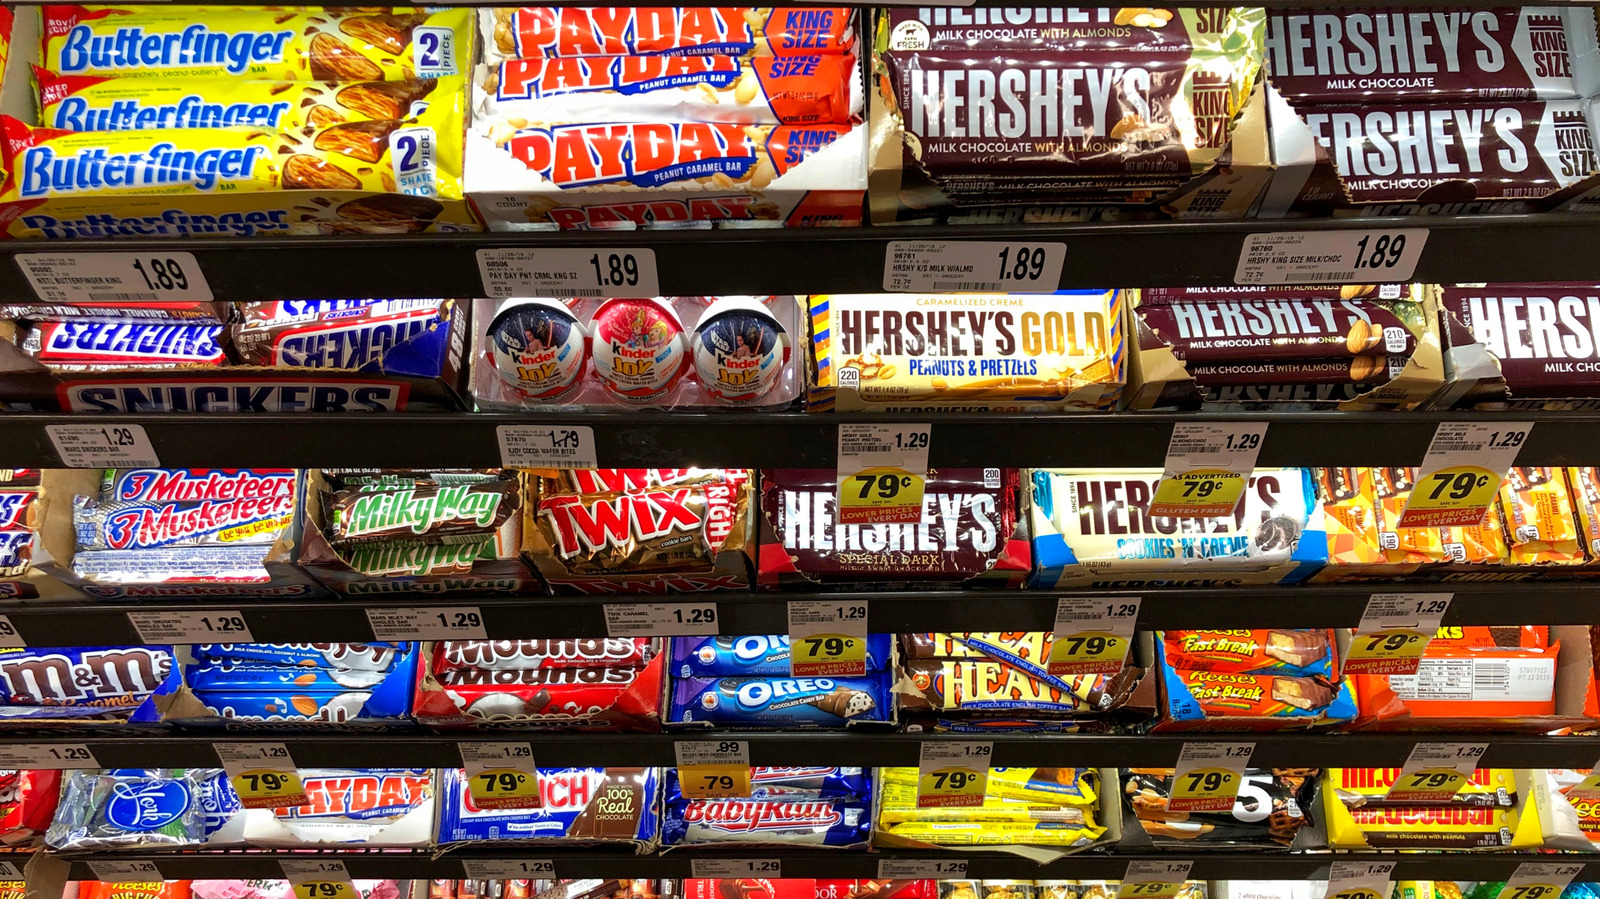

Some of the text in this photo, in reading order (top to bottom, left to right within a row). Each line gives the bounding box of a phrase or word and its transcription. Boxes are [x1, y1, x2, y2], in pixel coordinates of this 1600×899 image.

[786, 10, 833, 29] KING
[514, 8, 753, 59] PAYDAY
[782, 30, 829, 48] SIZE
[936, 27, 1131, 40] MILK CHOCOLATE WITH ALMONDS
[61, 25, 292, 73] Butterfinger
[1266, 11, 1506, 77] HERSHEY'S
[1530, 32, 1567, 52] KING
[419, 32, 441, 68] 2
[442, 34, 452, 68] PIECE
[687, 48, 723, 56] CARAMEL
[1533, 53, 1573, 78] SIZE
[639, 74, 727, 91] PEANUT CARAMEL BAR
[1327, 77, 1435, 90] MILK CHOCOLATE
[911, 68, 1150, 139] HERSHEY'S
[1555, 129, 1593, 150] KING
[398, 136, 419, 171] 2
[511, 124, 752, 182] PAYDAY
[928, 141, 1128, 154] MILK CHOCOLATE WITH ALMONDS
[22, 143, 264, 197] Butterfinger
[654, 161, 742, 182] PEANUT CARAMEL BAR
[219, 183, 238, 191] BAR
[1354, 234, 1407, 269] 1.89
[998, 246, 1046, 281] 1.89
[1271, 256, 1288, 264] KING
[1290, 255, 1304, 263] SIZE
[1305, 255, 1342, 263] MILK/CHOC
[133, 258, 189, 290] 1.89
[590, 253, 639, 287] 1.89
[916, 299, 1024, 307] CARAMELIZED CREME
[841, 309, 1105, 357] HERSHEY'S GOLD
[1386, 329, 1404, 339] 210
[612, 341, 655, 359] kinder
[1190, 341, 1212, 349] MILK
[1213, 339, 1271, 349] CHOCOLATE
[1272, 338, 1296, 347] WITH
[512, 350, 556, 365] kinder
[717, 353, 761, 369] kinder
[909, 358, 1038, 377] PEANUTS & PRETZELS
[1194, 363, 1348, 375] MILK CHOCOLATE WITH ALMONDS
[840, 370, 858, 381] 220
[79, 386, 391, 413] SNICKERS
[101, 427, 136, 446] 1.29
[895, 432, 929, 449] 1.29
[1225, 433, 1261, 450] 1.29
[1488, 431, 1526, 447] 1.29
[984, 469, 1000, 478] 200
[1184, 472, 1242, 480] ADVERTISED
[855, 475, 912, 499] 79¢
[1181, 480, 1224, 498] 79¢
[1428, 472, 1490, 500] 79¢
[841, 507, 913, 521] LOWER PRICES
[866, 511, 921, 524] EVERY DAY
[1403, 508, 1478, 523] LOWER PRICES
[1427, 513, 1483, 527] EVERY DAY
[108, 496, 296, 549] 3 Musketeers
[661, 535, 693, 547] cookie bars
[840, 554, 939, 565] SPECIAL DARK
[837, 606, 866, 619] 1.29
[1106, 604, 1137, 617] 1.29
[1416, 600, 1447, 614] 1.29
[437, 612, 481, 628] 1.29
[673, 608, 715, 624] 1.29
[201, 617, 246, 633] 1.29
[804, 637, 854, 657] 79¢
[1066, 636, 1118, 656] 79¢
[1184, 638, 1257, 656] Fast Break
[1366, 634, 1420, 651] 79¢
[1345, 658, 1412, 672] LOWER PRICES
[1368, 662, 1418, 674] EVERY DAY
[2, 650, 173, 700] m&m's
[738, 678, 835, 706] OREO
[769, 700, 799, 710] CHOCOLATE
[799, 697, 817, 706] CANDY
[1181, 702, 1192, 715] 18
[49, 747, 91, 760] 1.29
[259, 747, 288, 758] 1.29
[503, 747, 531, 757] 1.29
[716, 741, 740, 753] .99
[964, 746, 991, 756] 1.29
[1225, 745, 1253, 757] 1.29
[1455, 746, 1485, 757] 1.29
[241, 773, 290, 792] 79¢
[480, 773, 526, 792] 79¢
[700, 776, 734, 790] .79
[932, 771, 977, 789] 79¢
[1187, 771, 1232, 793] 79¢
[1409, 773, 1459, 787] 79¢
[606, 789, 635, 800] 100%
[920, 794, 977, 805] LOWER PRICES
[1235, 775, 1274, 822] 5
[596, 797, 635, 813] Real
[1442, 833, 1466, 841] peanuts
[130, 862, 155, 873] 1.29
[318, 862, 344, 872] 1.29
[520, 861, 553, 873] 1.29
[747, 861, 780, 872] 1.29
[935, 862, 967, 873] 1.29
[1166, 864, 1190, 873] 1.29
[1367, 864, 1392, 874] 1.29
[1554, 865, 1580, 875] 1.29
[1134, 883, 1172, 894] 79¢
[1507, 886, 1553, 899] 79¢
